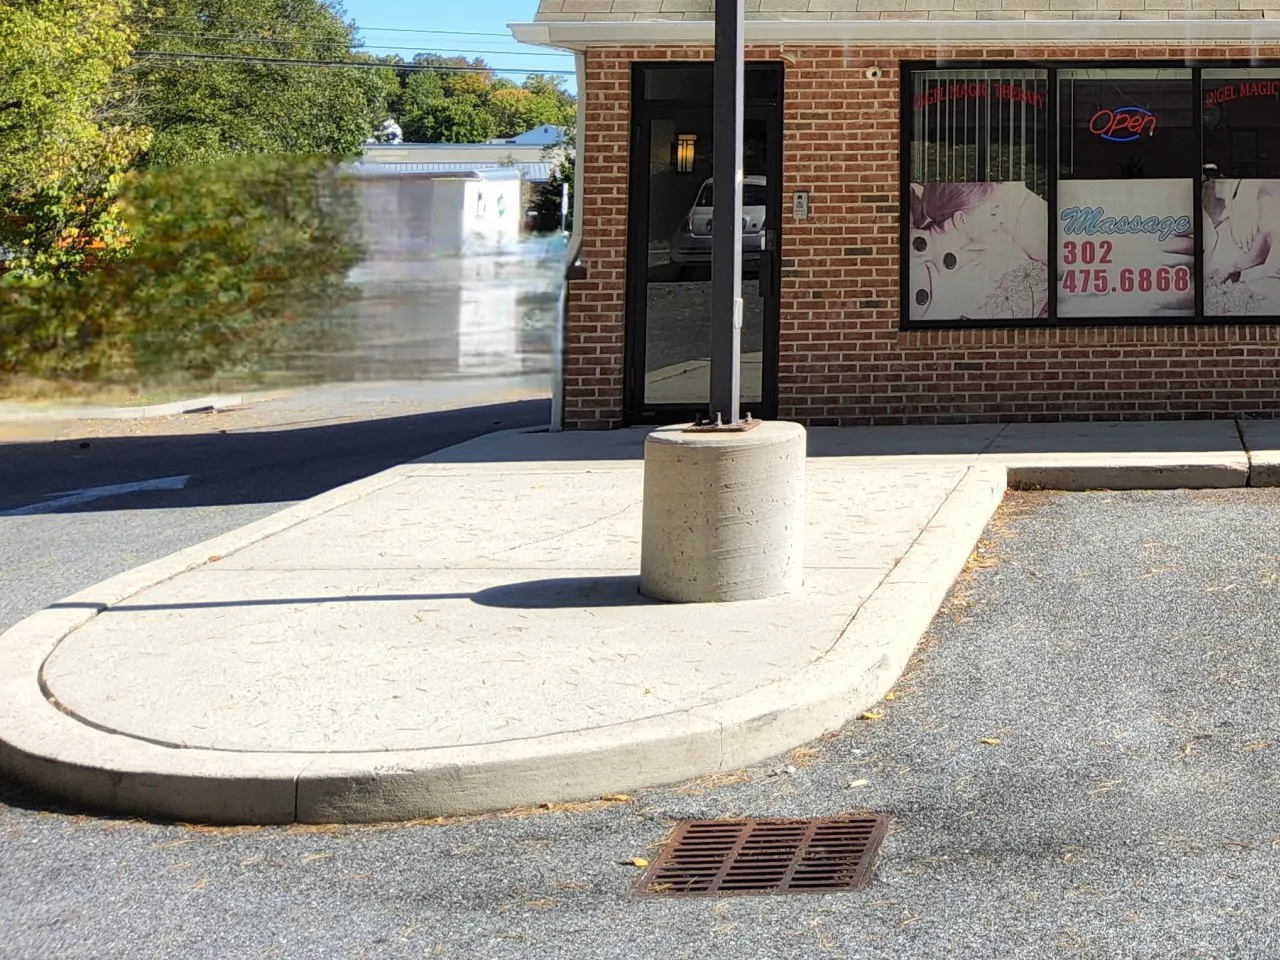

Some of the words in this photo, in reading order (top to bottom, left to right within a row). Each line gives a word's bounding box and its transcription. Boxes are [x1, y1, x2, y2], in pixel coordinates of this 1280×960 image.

[949, 81, 989, 100] MAGIC
[993, 81, 1045, 109] THERAPY
[1204, 84, 1237, 108] ANGEL
[1239, 80, 1279, 99] MAGIC
[1089, 109, 1157, 137] Open
[1061, 206, 1191, 241] Massage
[1063, 241, 1113, 265] 302
[1062, 267, 1190, 293] 475.6868
